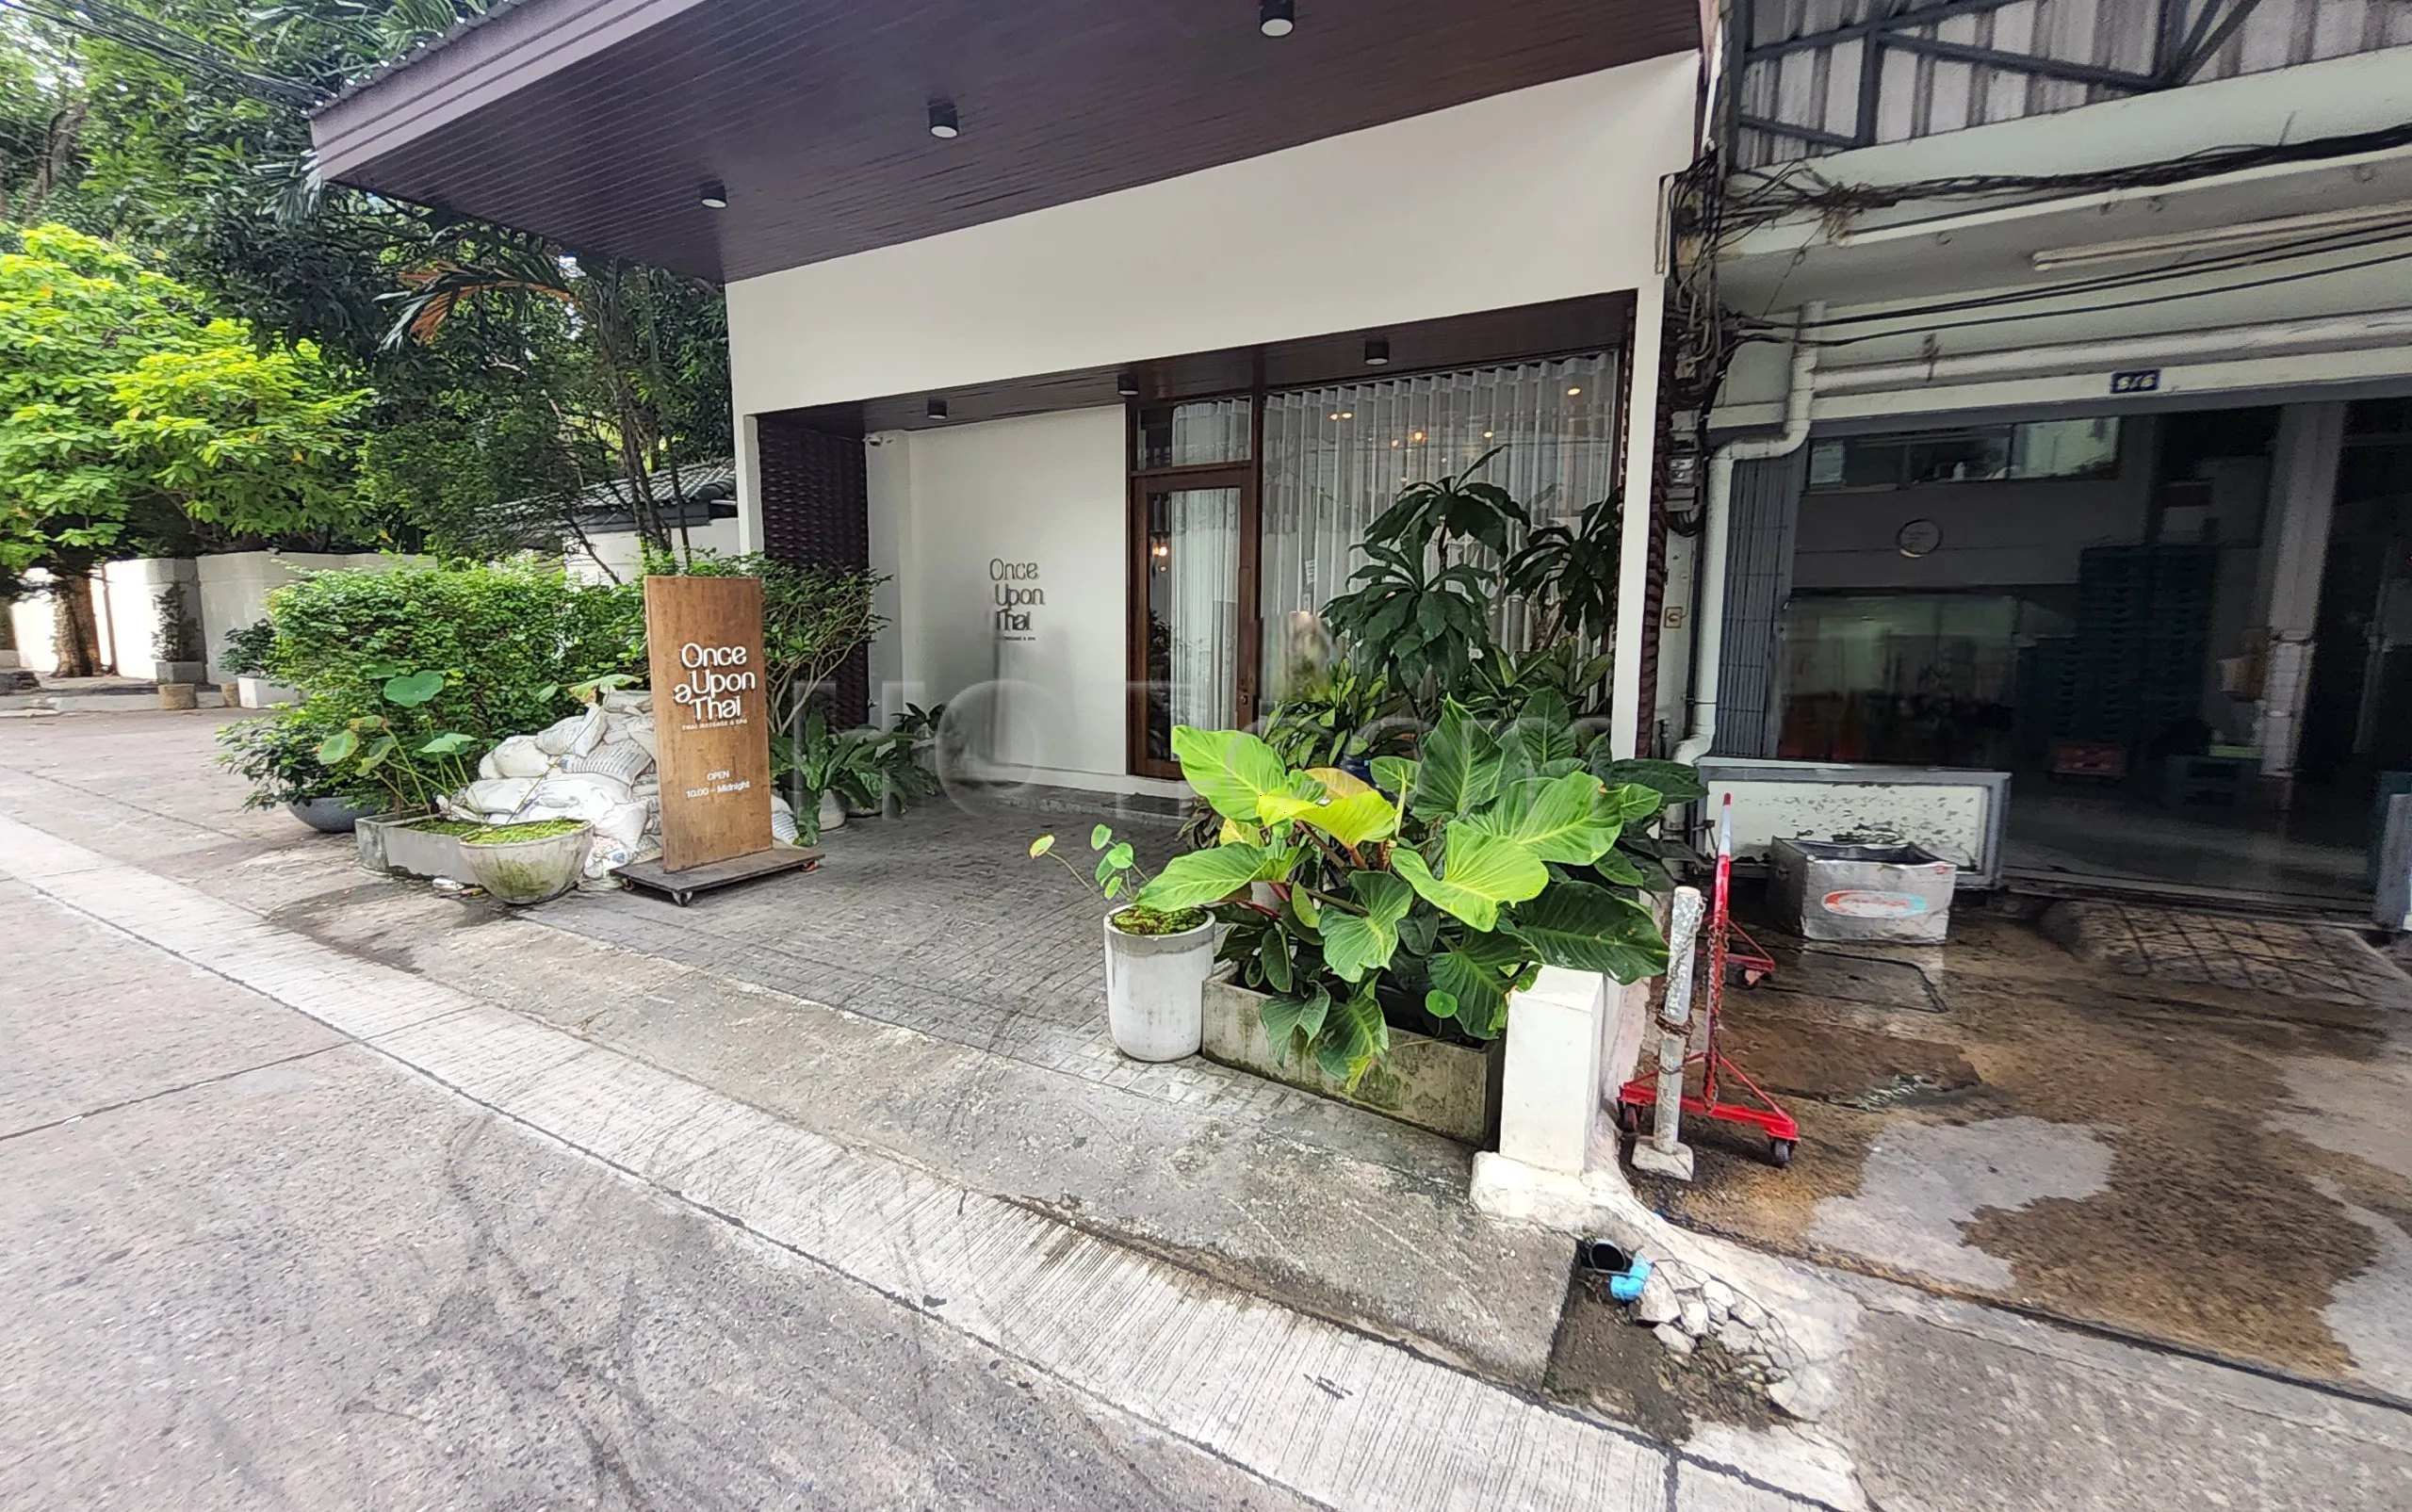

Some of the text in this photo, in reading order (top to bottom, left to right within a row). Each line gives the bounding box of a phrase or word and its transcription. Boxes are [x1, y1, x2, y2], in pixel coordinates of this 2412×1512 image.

[989, 558, 1039, 581] Once
[994, 583, 1045, 611] Upon
[680, 642, 747, 669] Once
[691, 668, 756, 699] Upon
[673, 683, 742, 721] a Thai
[707, 770, 730, 781] OPEN
[717, 780, 751, 793] Midnight
